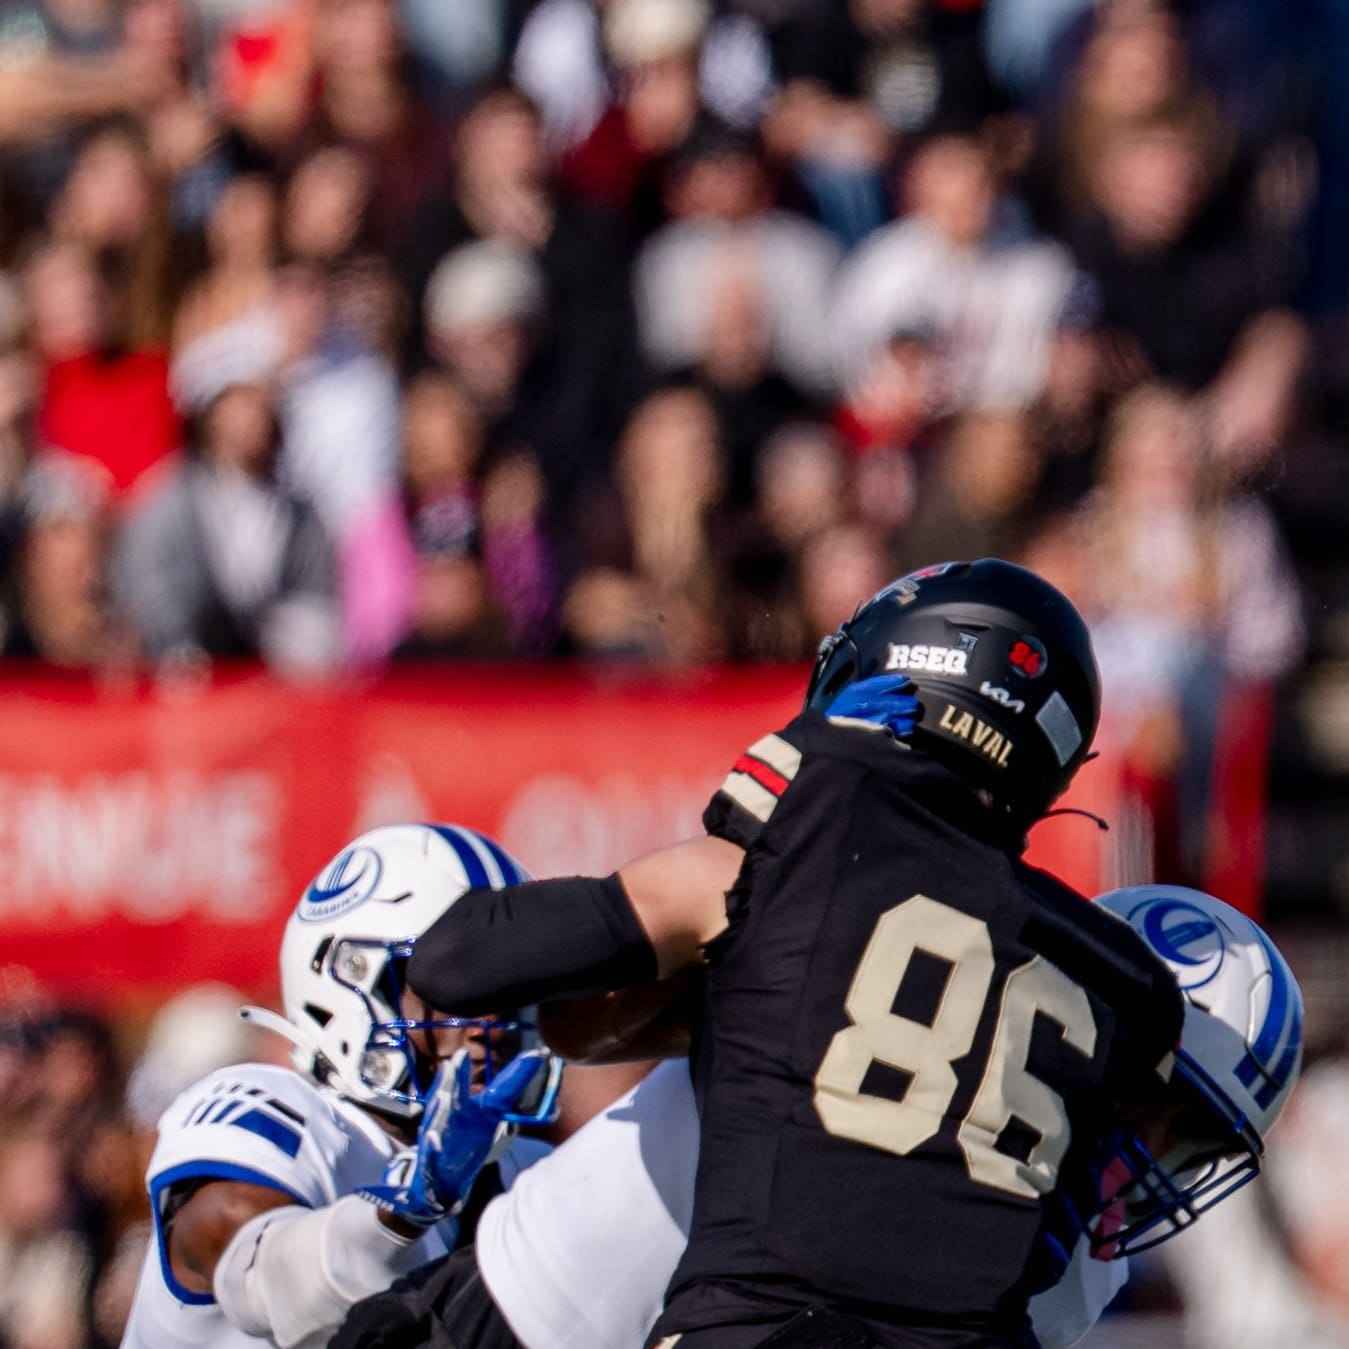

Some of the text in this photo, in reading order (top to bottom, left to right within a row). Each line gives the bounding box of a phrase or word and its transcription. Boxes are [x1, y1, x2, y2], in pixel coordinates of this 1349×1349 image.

[885, 642, 968, 676] RSEQ
[1008, 640, 1041, 676] 86
[939, 704, 1014, 767] LAVAL
[813, 893, 1098, 1200] 86
